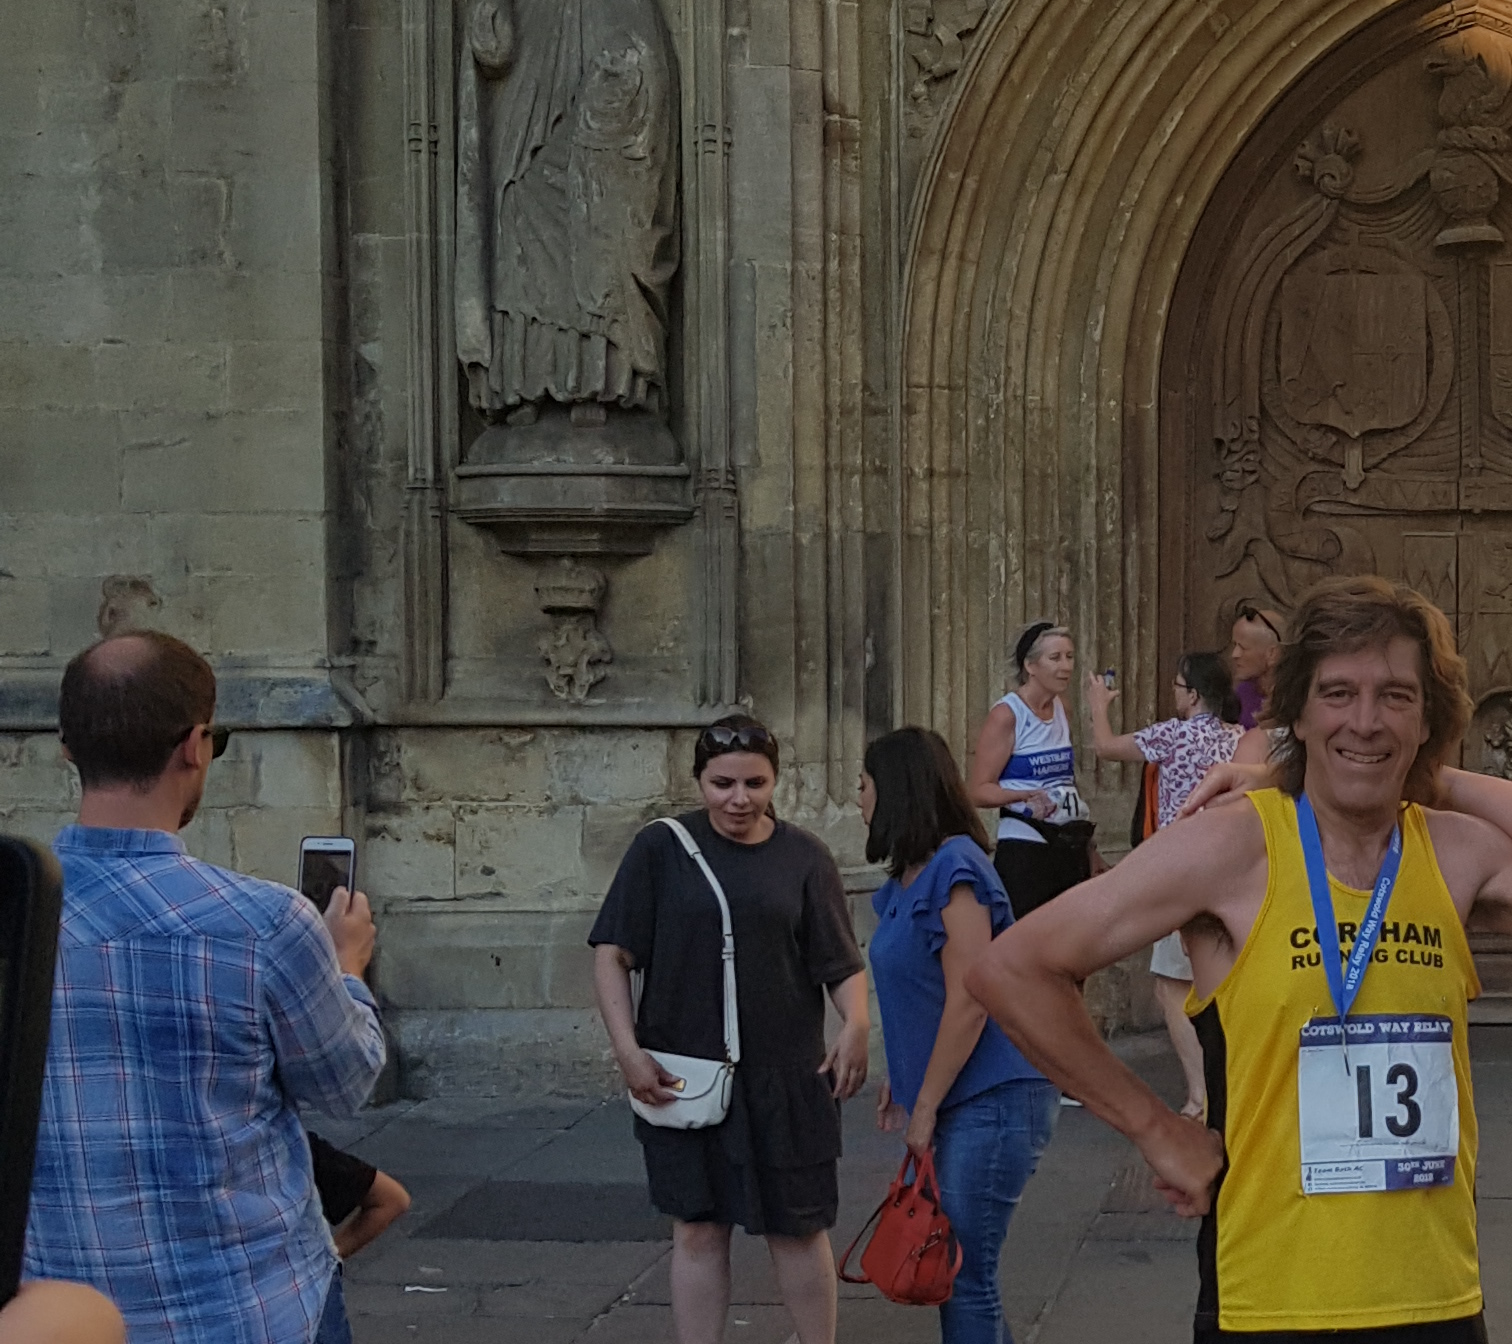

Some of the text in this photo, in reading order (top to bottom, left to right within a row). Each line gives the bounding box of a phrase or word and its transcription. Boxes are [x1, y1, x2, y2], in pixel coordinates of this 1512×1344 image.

[1062, 791, 1079, 817] 41
[1371, 877, 1391, 919] Cotswold
[1290, 921, 1443, 949] CRHAM
[1361, 919, 1378, 942] Way
[1395, 948, 1444, 968] CLUB
[1345, 965, 1361, 991] 2018
[1378, 1021, 1411, 1034] WAY
[1413, 1020, 1451, 1034] RELAY
[1355, 1062, 1422, 1139] 13
